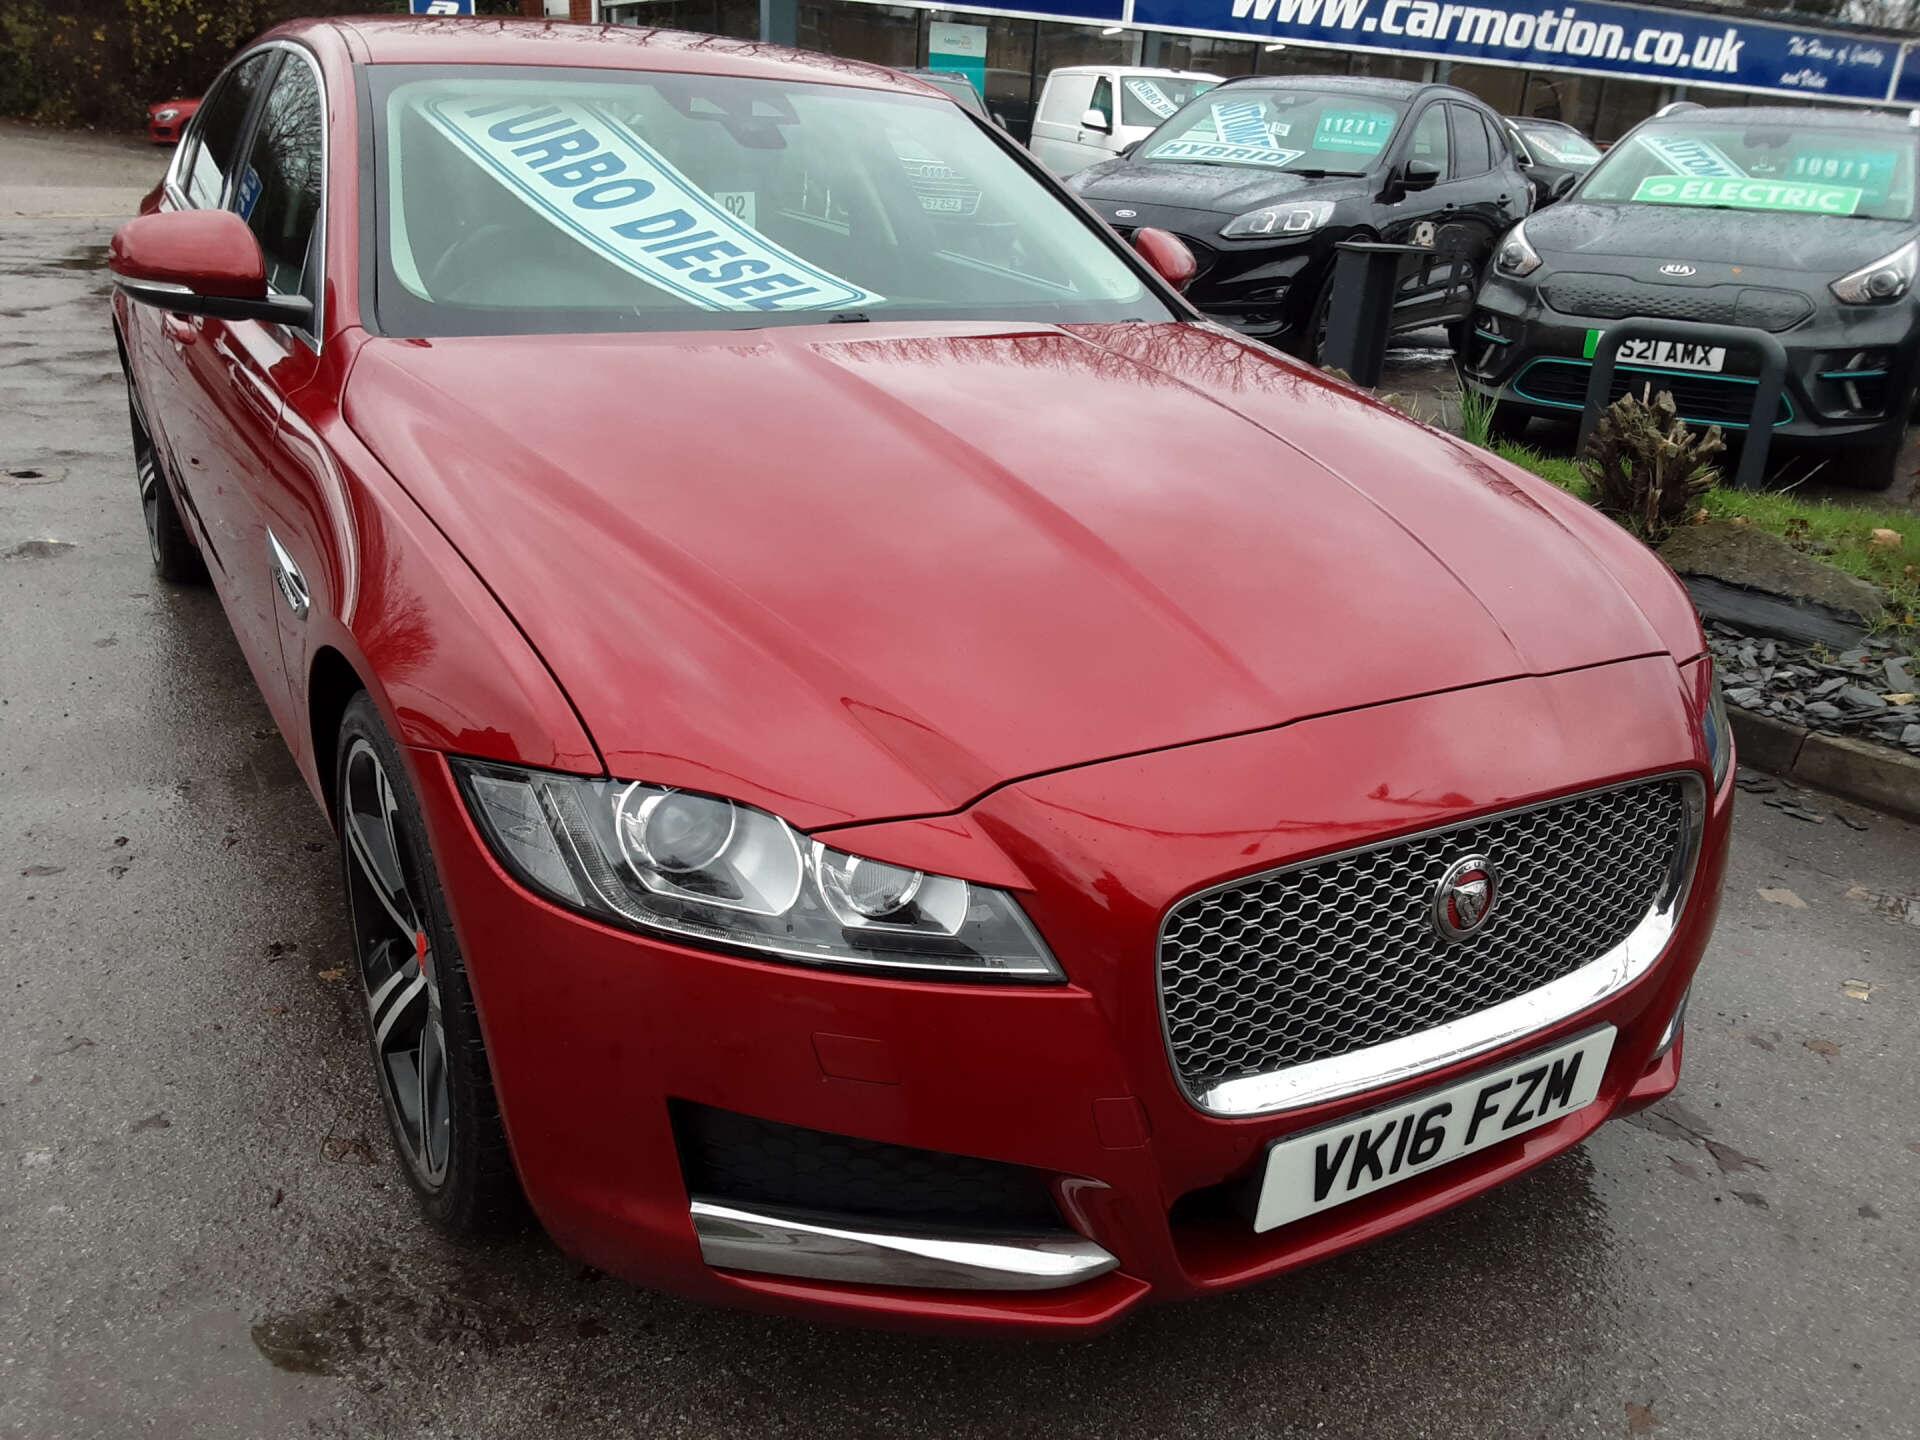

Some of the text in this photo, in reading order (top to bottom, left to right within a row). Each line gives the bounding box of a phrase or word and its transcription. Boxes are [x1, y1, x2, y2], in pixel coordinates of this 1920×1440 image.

[1231, 0, 1745, 73] www.carmotion.co.uk
[1133, 80, 1160, 105] TURBO
[1323, 117, 1377, 136] 11271
[1159, 143, 1288, 162] HYBRID
[463, 101, 822, 311] TURBO DIESEL
[724, 195, 746, 220] 92
[1677, 181, 1846, 210] ELECTRIC
[1664, 264, 1691, 274] KIA
[1664, 341, 1712, 366] AMX
[1313, 1050, 1585, 1203] VK16 FZM
